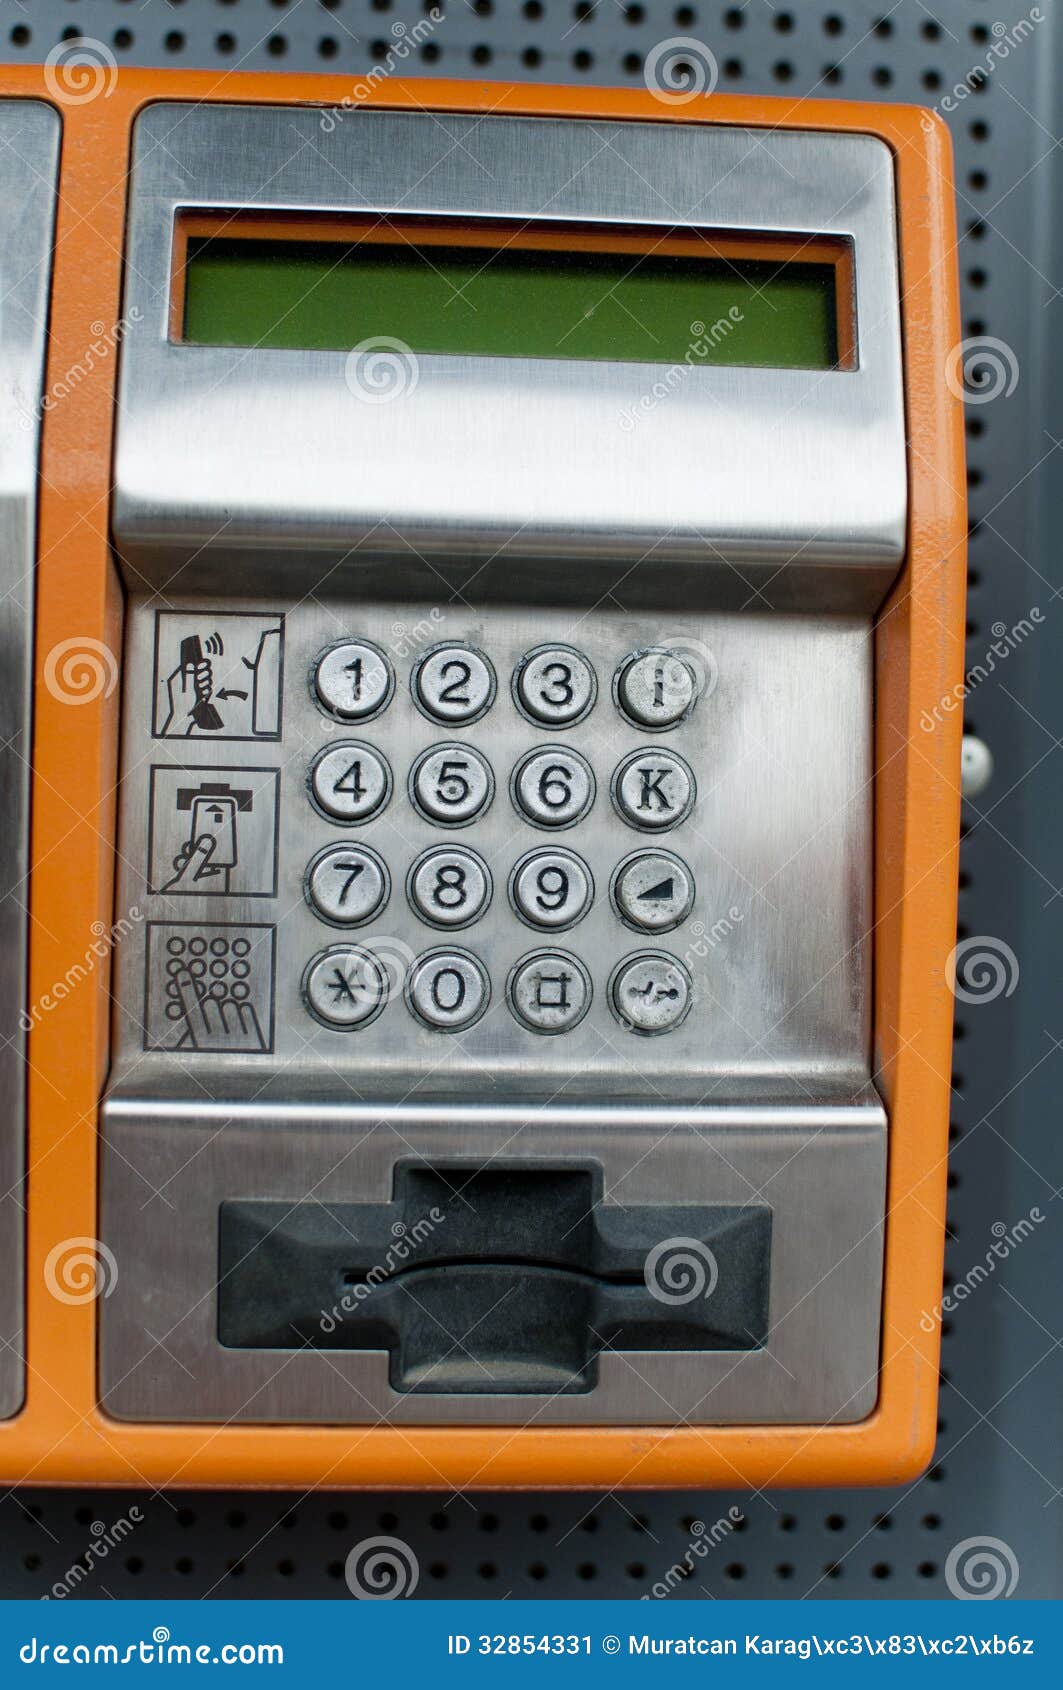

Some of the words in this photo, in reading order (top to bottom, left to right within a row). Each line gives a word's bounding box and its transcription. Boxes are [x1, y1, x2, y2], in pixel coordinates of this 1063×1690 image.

[344, 658, 364, 700] 1
[440, 660, 470, 704] 2
[540, 662, 572, 705] 3
[333, 761, 367, 803] 4
[436, 761, 469, 805] 5
[538, 765, 572, 808] 6
[637, 768, 675, 810] K
[333, 864, 364, 906] 7
[433, 865, 467, 908] 8
[535, 866, 569, 910] 9
[431, 968, 465, 1011] 0
